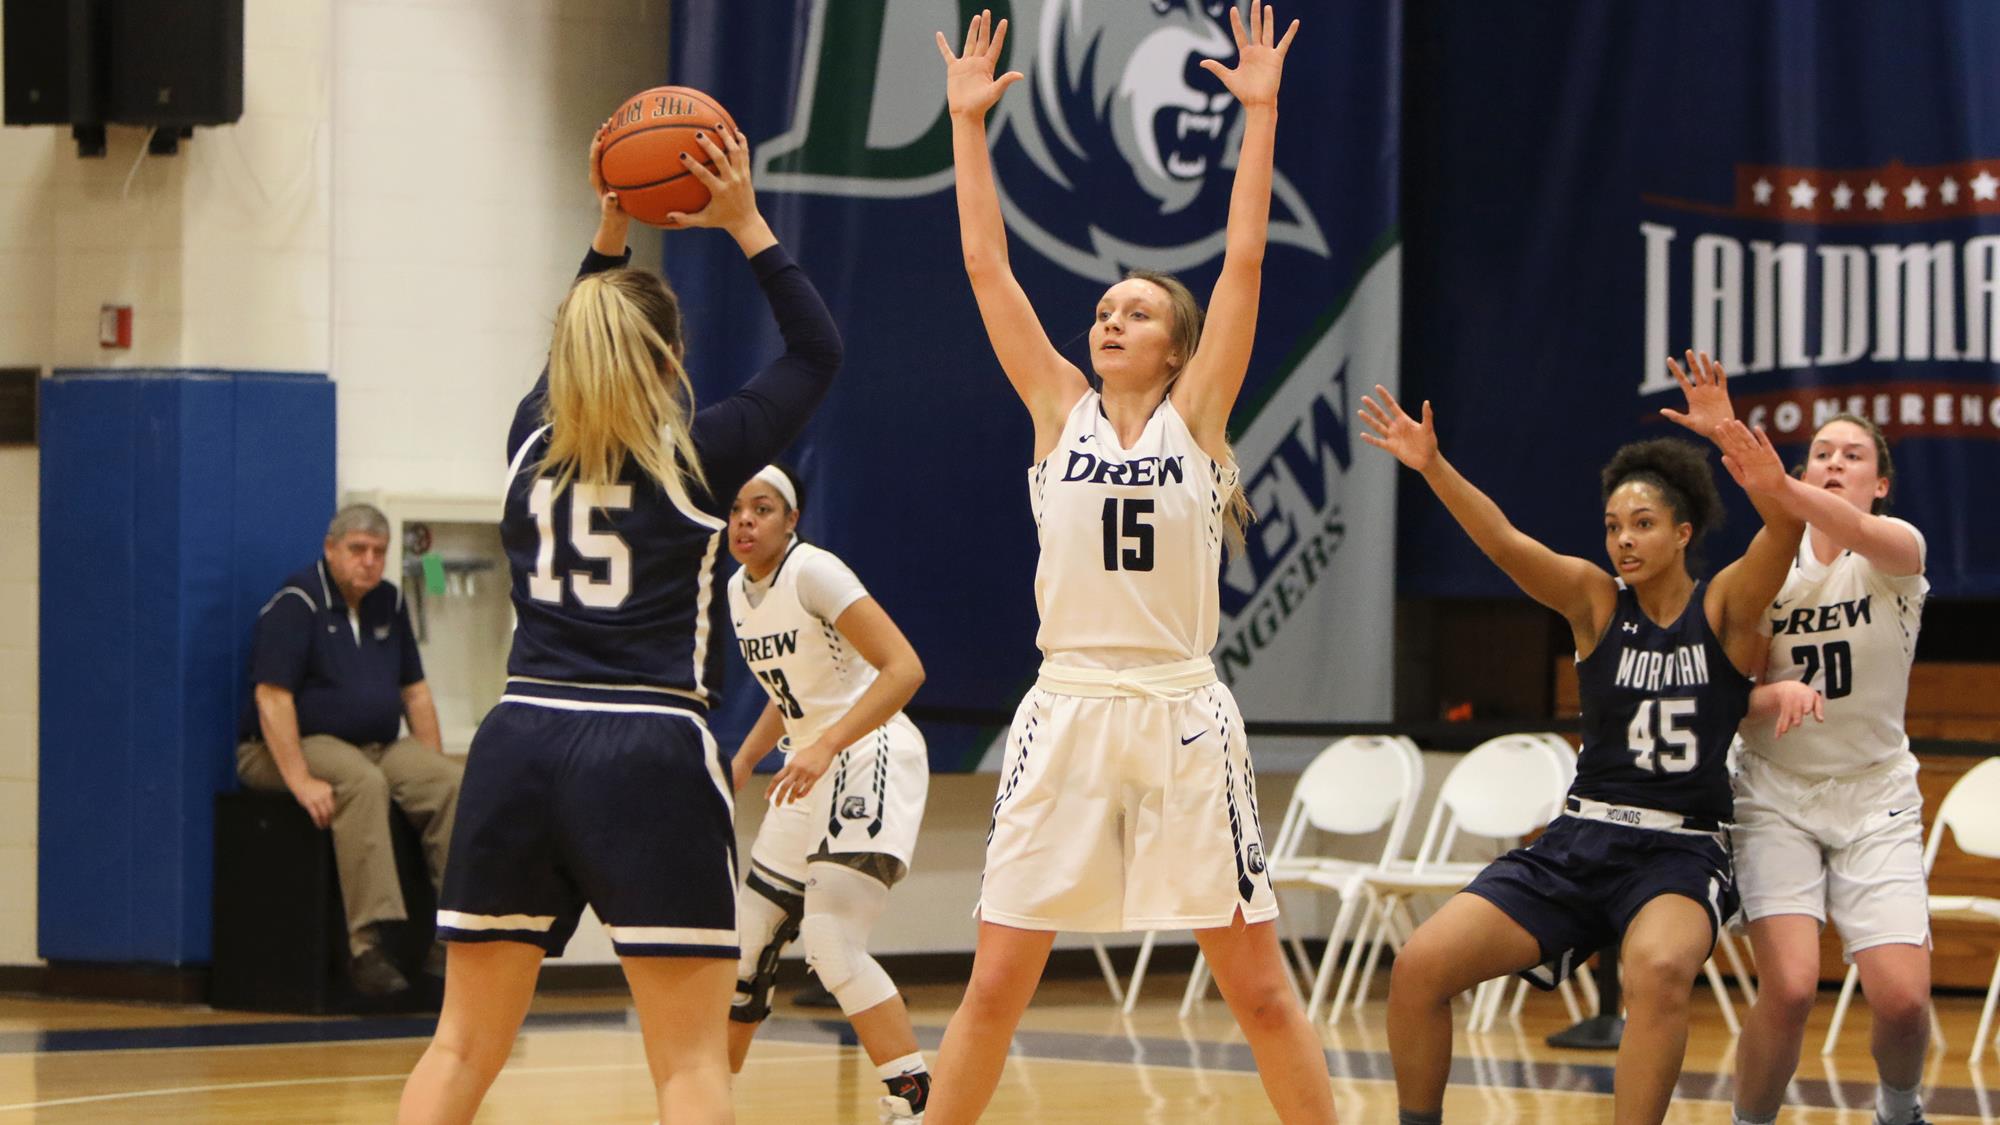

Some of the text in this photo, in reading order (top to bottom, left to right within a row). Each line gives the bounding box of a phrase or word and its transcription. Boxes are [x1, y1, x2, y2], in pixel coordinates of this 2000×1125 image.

[652, 97, 697, 119] THE
[1061, 450, 1184, 487] DREW
[527, 477, 634, 610] 15
[1101, 497, 1155, 572] 15
[1219, 506, 1347, 686] NGERS
[1791, 640, 1852, 700] 20
[1628, 697, 1698, 774] 45
